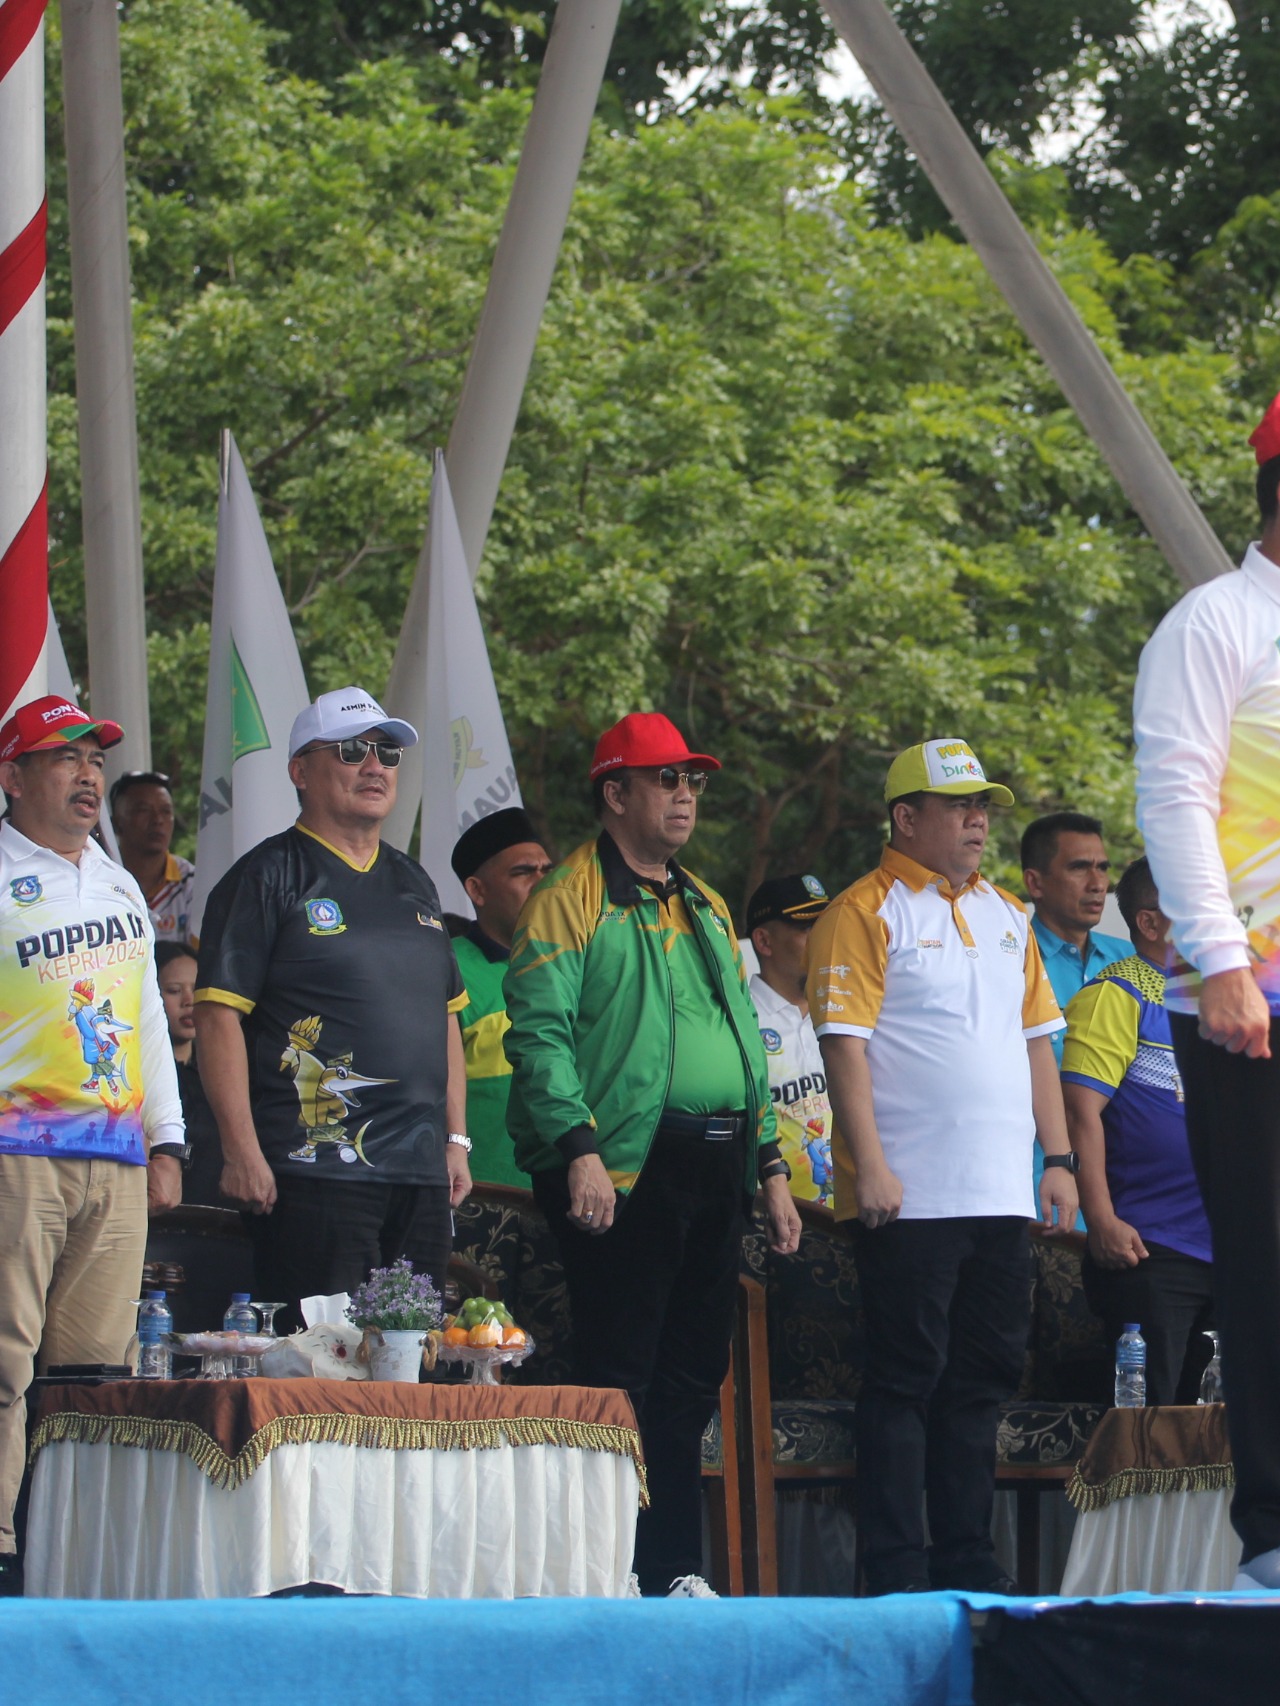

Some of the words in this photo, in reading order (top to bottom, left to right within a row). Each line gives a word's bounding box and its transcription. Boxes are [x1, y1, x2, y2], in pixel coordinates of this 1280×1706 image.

[16, 914, 127, 969] POPDA
[37, 949, 101, 985] KEPRI
[105, 940, 146, 966] 2024
